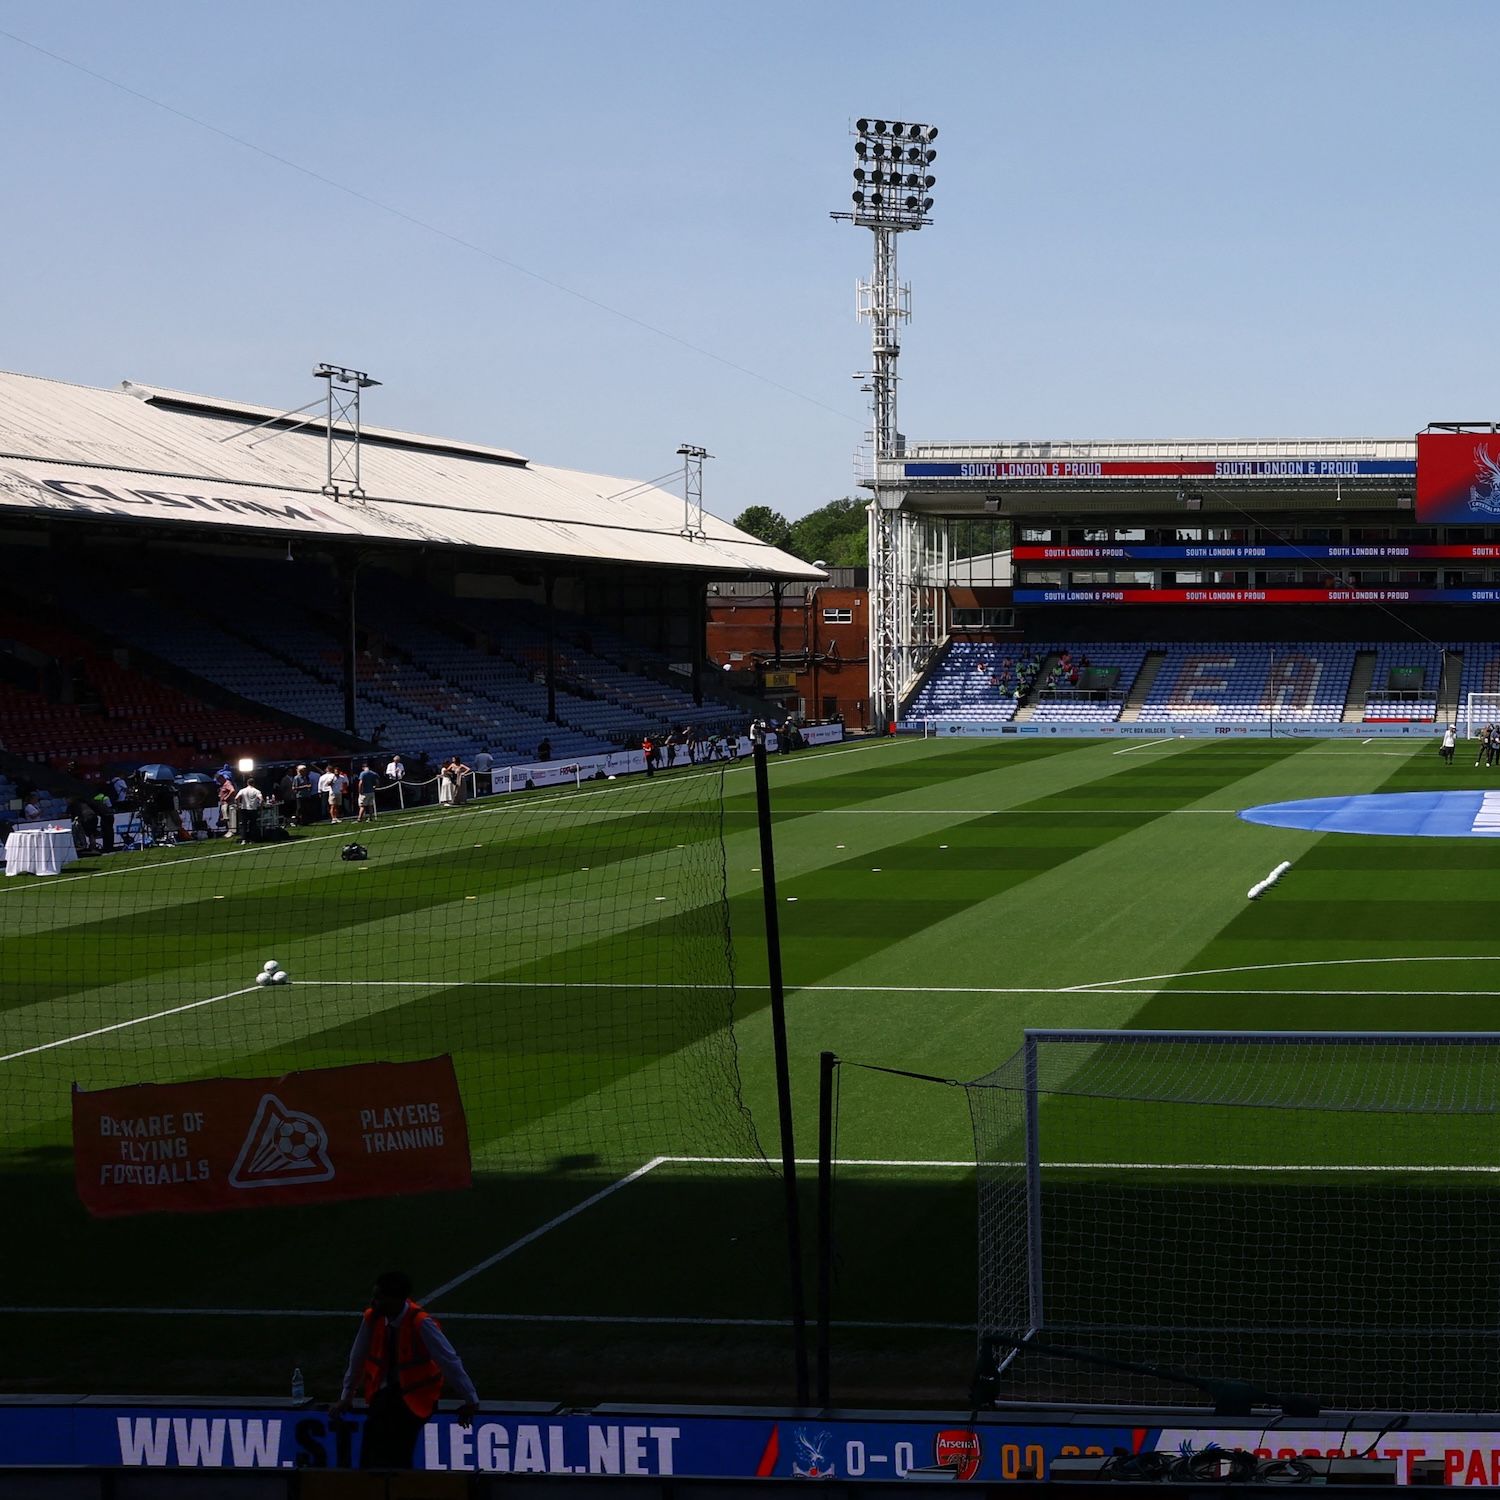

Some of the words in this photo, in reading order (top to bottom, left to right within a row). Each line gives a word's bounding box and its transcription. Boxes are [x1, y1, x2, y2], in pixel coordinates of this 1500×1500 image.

[961, 463, 997, 476] SOUTH
[1001, 463, 1047, 476] LONDON
[1052, 463, 1060, 475] &
[1065, 463, 1102, 475] PROUD
[1215, 462, 1252, 475] SOUTH
[1257, 462, 1303, 475] LONDON
[1308, 462, 1315, 475] &
[1321, 462, 1358, 475] PROUD
[1045, 548, 1065, 557] SOUTH
[1067, 548, 1093, 557] LONDON
[1102, 548, 1124, 557] PROUD
[1186, 548, 1207, 556] SOUTH
[1208, 548, 1235, 556] LONDON
[1243, 548, 1266, 556] PROUD
[1329, 548, 1350, 556] SOUTH
[1351, 548, 1378, 556] LONDON
[1387, 548, 1409, 556] PROUD
[1473, 548, 1494, 556] SOUTH
[1045, 592, 1065, 600] SOUTH
[1067, 592, 1093, 600] LONDON
[1186, 592, 1207, 600] SOUTH
[1208, 592, 1235, 600] LONDON
[1243, 592, 1266, 600] PROUD
[1329, 592, 1350, 600] SOUTH
[1351, 592, 1378, 600] LONDON
[1387, 592, 1409, 600] PROUD
[1473, 592, 1494, 600] SOUTH
[360, 1103, 440, 1130] PLAYERS
[100, 1113, 175, 1137] BEWARE
[183, 1111, 204, 1133] OF
[362, 1126, 444, 1153] TRAINING
[121, 1137, 189, 1161] FLYING
[100, 1159, 209, 1185] FOOTBALLS
